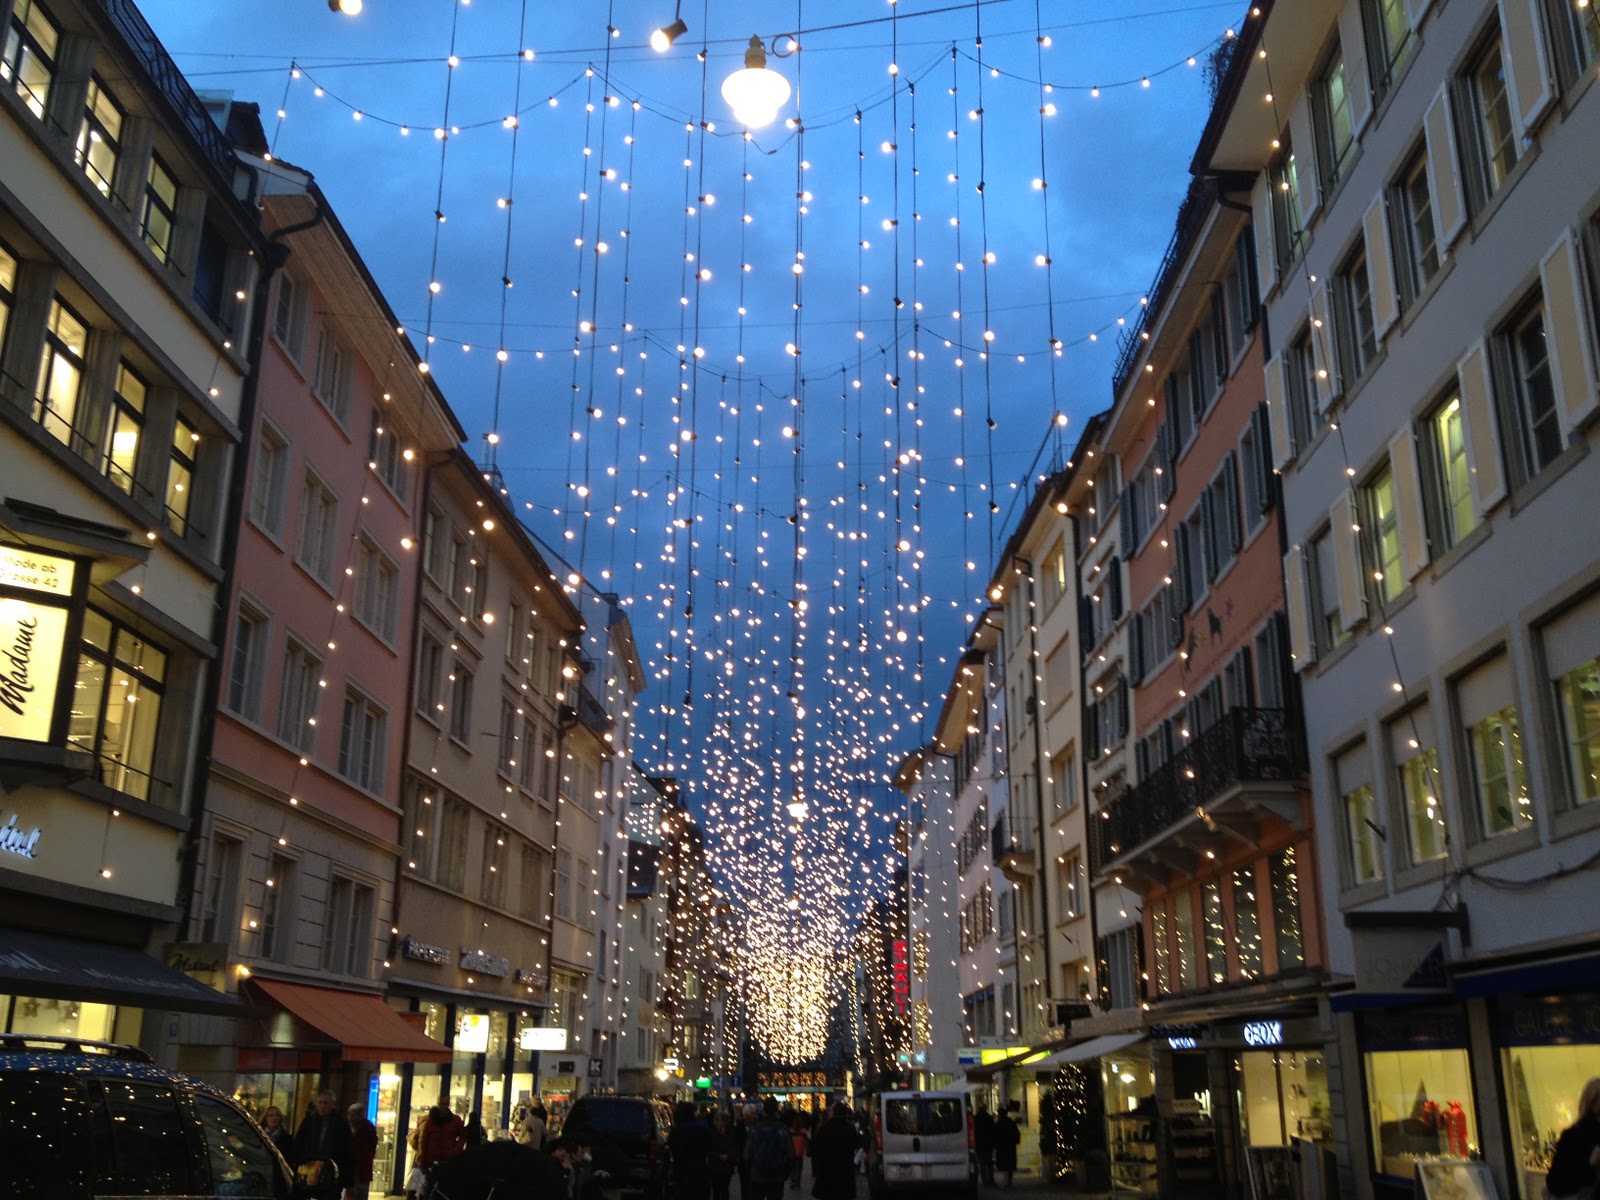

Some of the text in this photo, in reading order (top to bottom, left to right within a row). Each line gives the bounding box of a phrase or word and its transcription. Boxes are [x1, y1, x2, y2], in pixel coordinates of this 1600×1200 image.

[41, 563, 57, 574] ab
[43, 578, 59, 588] 42
[0, 616, 38, 716] Madame
[1243, 1020, 1283, 1046] GEOX
